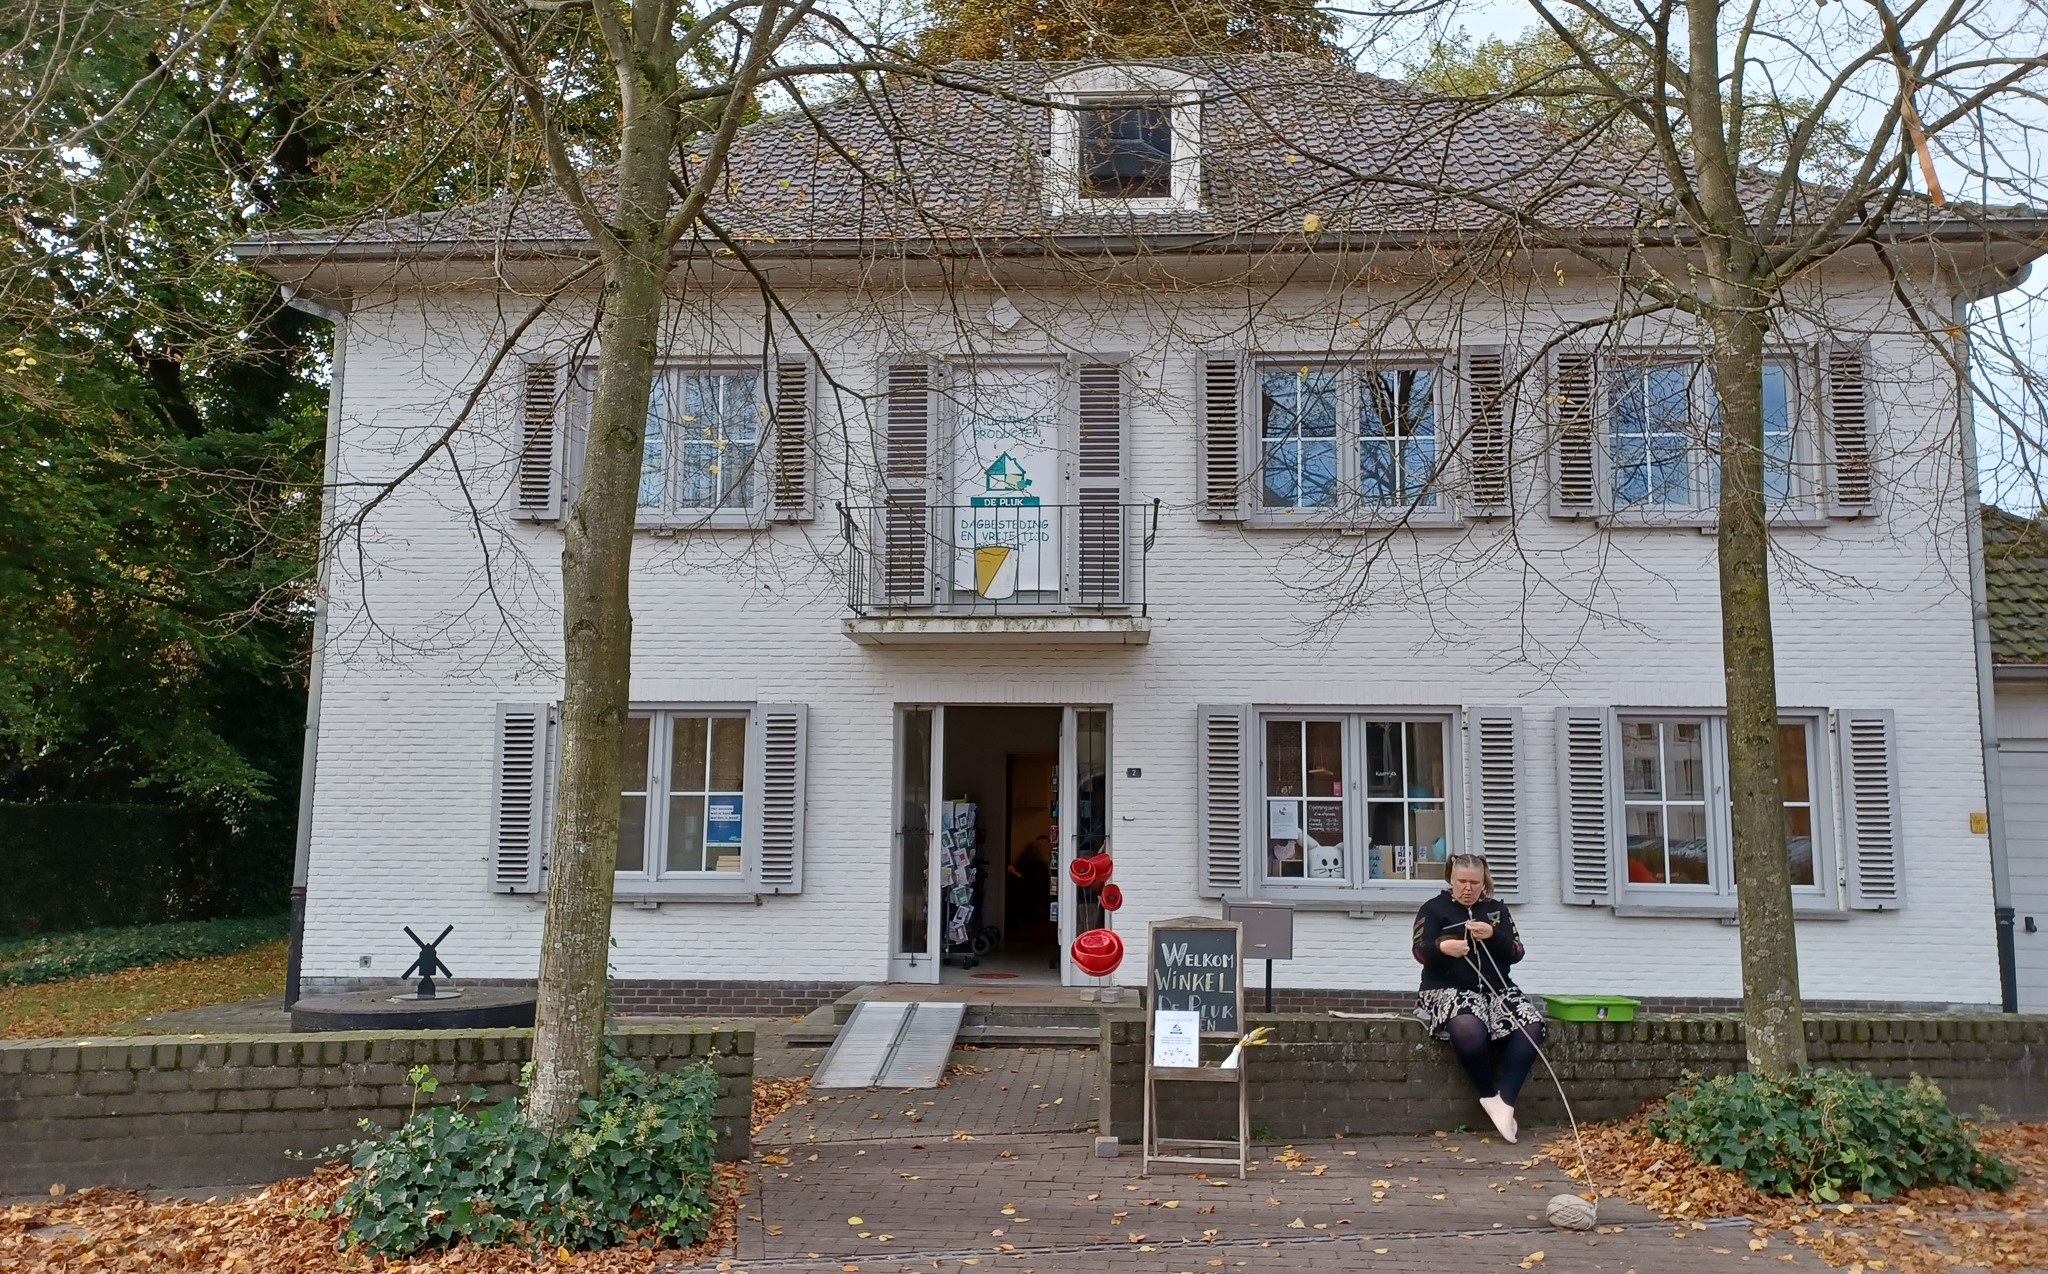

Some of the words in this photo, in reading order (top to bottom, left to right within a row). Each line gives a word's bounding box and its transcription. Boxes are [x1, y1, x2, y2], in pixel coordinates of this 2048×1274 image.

[983, 498, 997, 507] DE
[999, 498, 1024, 507] PLUK
[960, 519, 1049, 529] DAGBESTEDING
[960, 530, 975, 541] EN
[1022, 531, 1050, 542] TIJD
[1161, 942, 1234, 968] WELKOM
[1188, 994, 1234, 1019] PLUK
